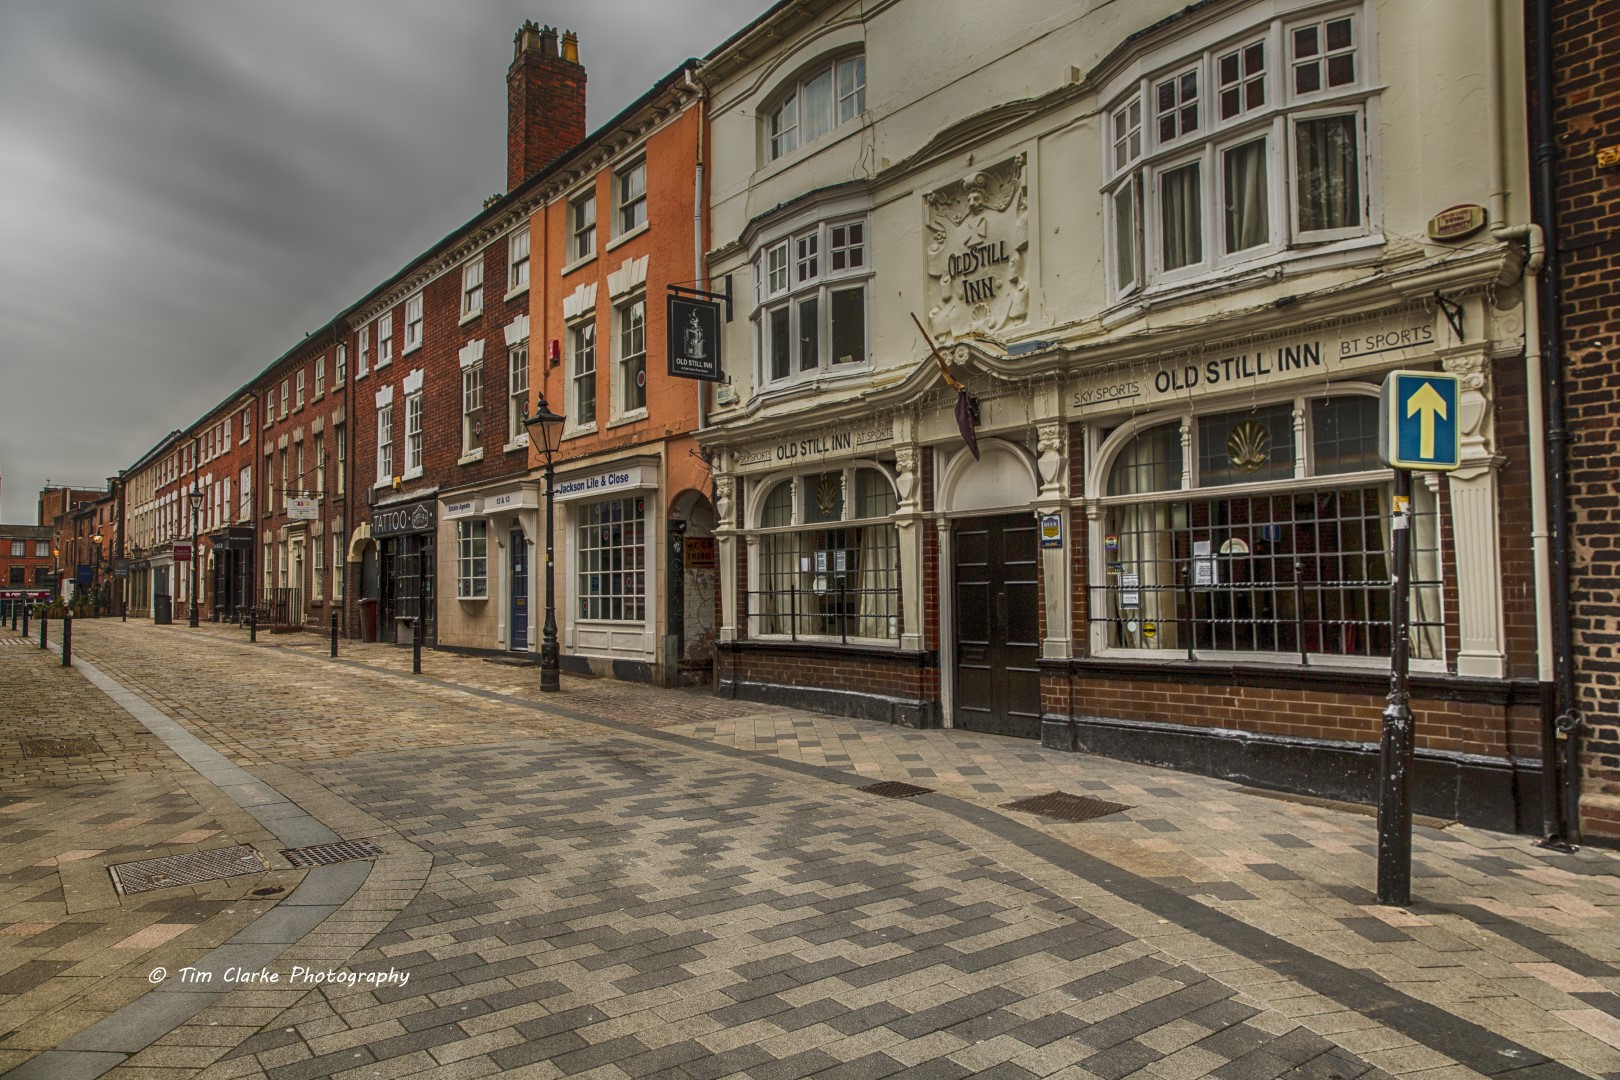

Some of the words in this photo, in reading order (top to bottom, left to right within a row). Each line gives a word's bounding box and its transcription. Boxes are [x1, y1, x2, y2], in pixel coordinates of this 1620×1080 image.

[948, 252, 972, 280] OLD
[964, 240, 1009, 277] STILL
[962, 276, 995, 304] INN
[1340, 340, 1363, 356] BT
[1365, 325, 1433, 351] SPORTS
[676, 357, 688, 366] OLD
[688, 359, 703, 368] STILL
[703, 361, 713, 369] INN
[1154, 365, 1199, 394] OLD
[1206, 355, 1271, 385] STILL
[1278, 341, 1320, 372] INN
[1074, 389, 1094, 405] SKY
[1096, 381, 1140, 403] SPORTS
[866, 427, 894, 441] SPORTS
[751, 449, 772, 461] SPORTS
[777, 442, 798, 461] OLD
[800, 437, 829, 456] STILL
[832, 432, 851, 451] INN
[559, 481, 585, 495] Jackson
[586, 478, 599, 490] Lile
[601, 475, 606, 486] &
[608, 473, 629, 485] Close
[448, 504, 459, 512] Estate
[459, 502, 471, 511] Agents
[373, 510, 407, 533] TATTOO
